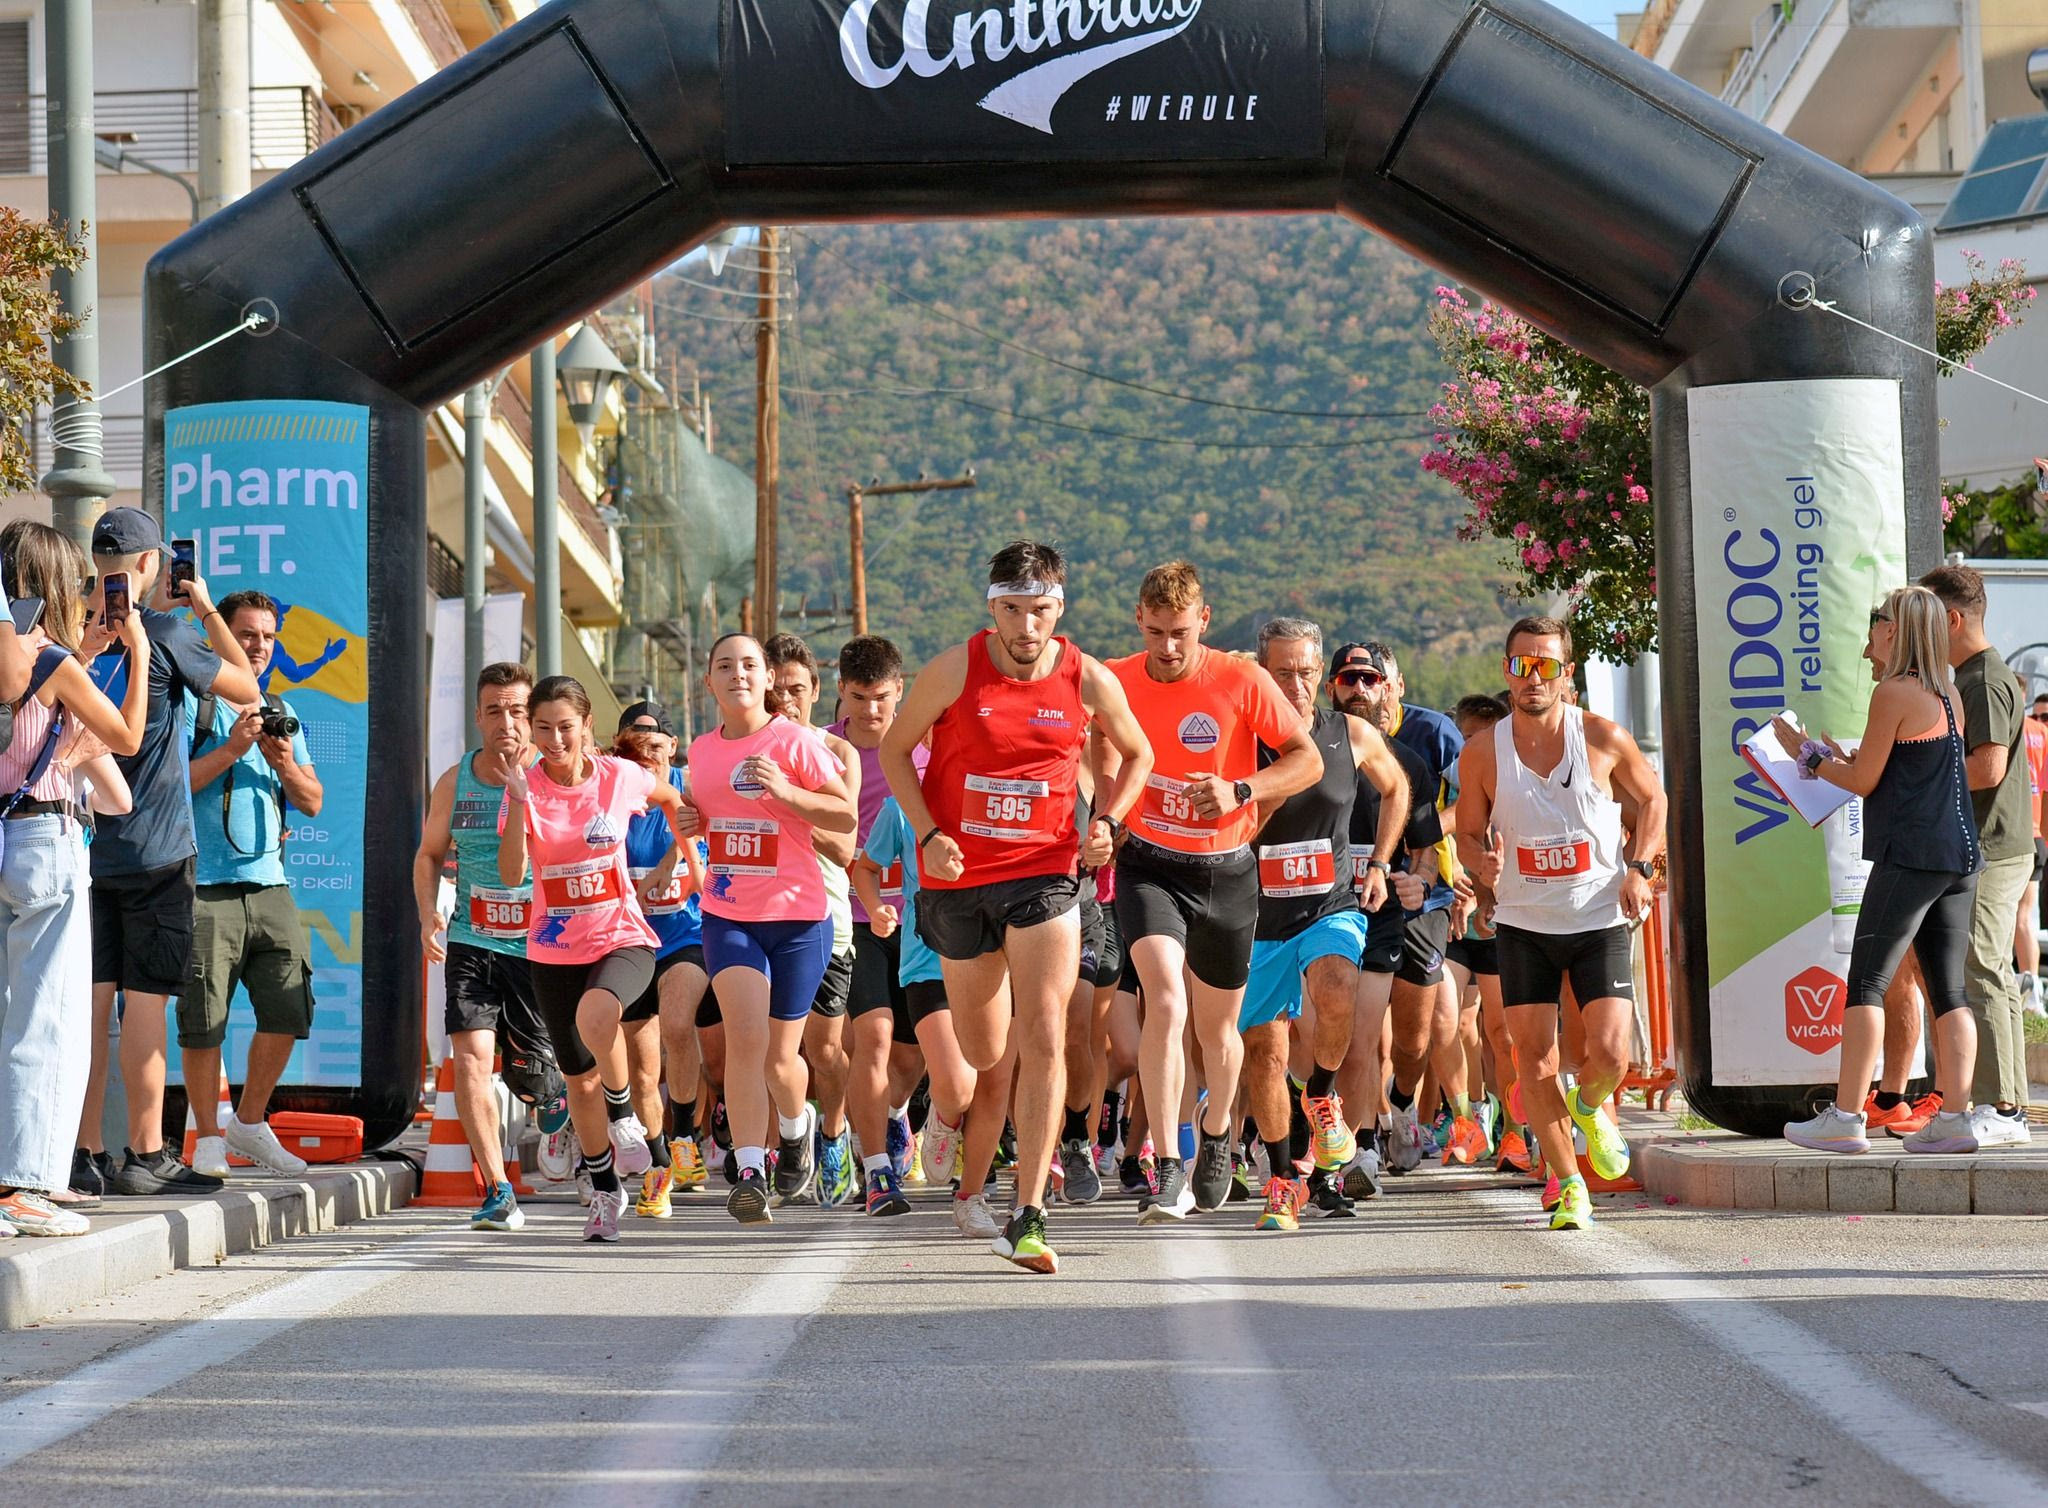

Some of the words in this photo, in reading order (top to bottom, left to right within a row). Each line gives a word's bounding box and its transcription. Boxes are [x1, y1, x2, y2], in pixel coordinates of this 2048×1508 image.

[1105, 95, 1258, 121] #WERULE
[171, 453, 358, 512] Pharm
[1786, 475, 1822, 529] gel
[171, 524, 297, 576] ET.
[1791, 543, 1823, 692] relaxing
[986, 796, 1032, 822] 595
[1848, 796, 1860, 837] VARID
[286, 824, 329, 842] άθε
[725, 833, 762, 858] 661
[1283, 856, 1318, 881] 641
[1534, 846, 1577, 871] 503
[566, 873, 607, 899] 662
[486, 903, 524, 924] 586
[1791, 1023, 1843, 1038] VICAN
